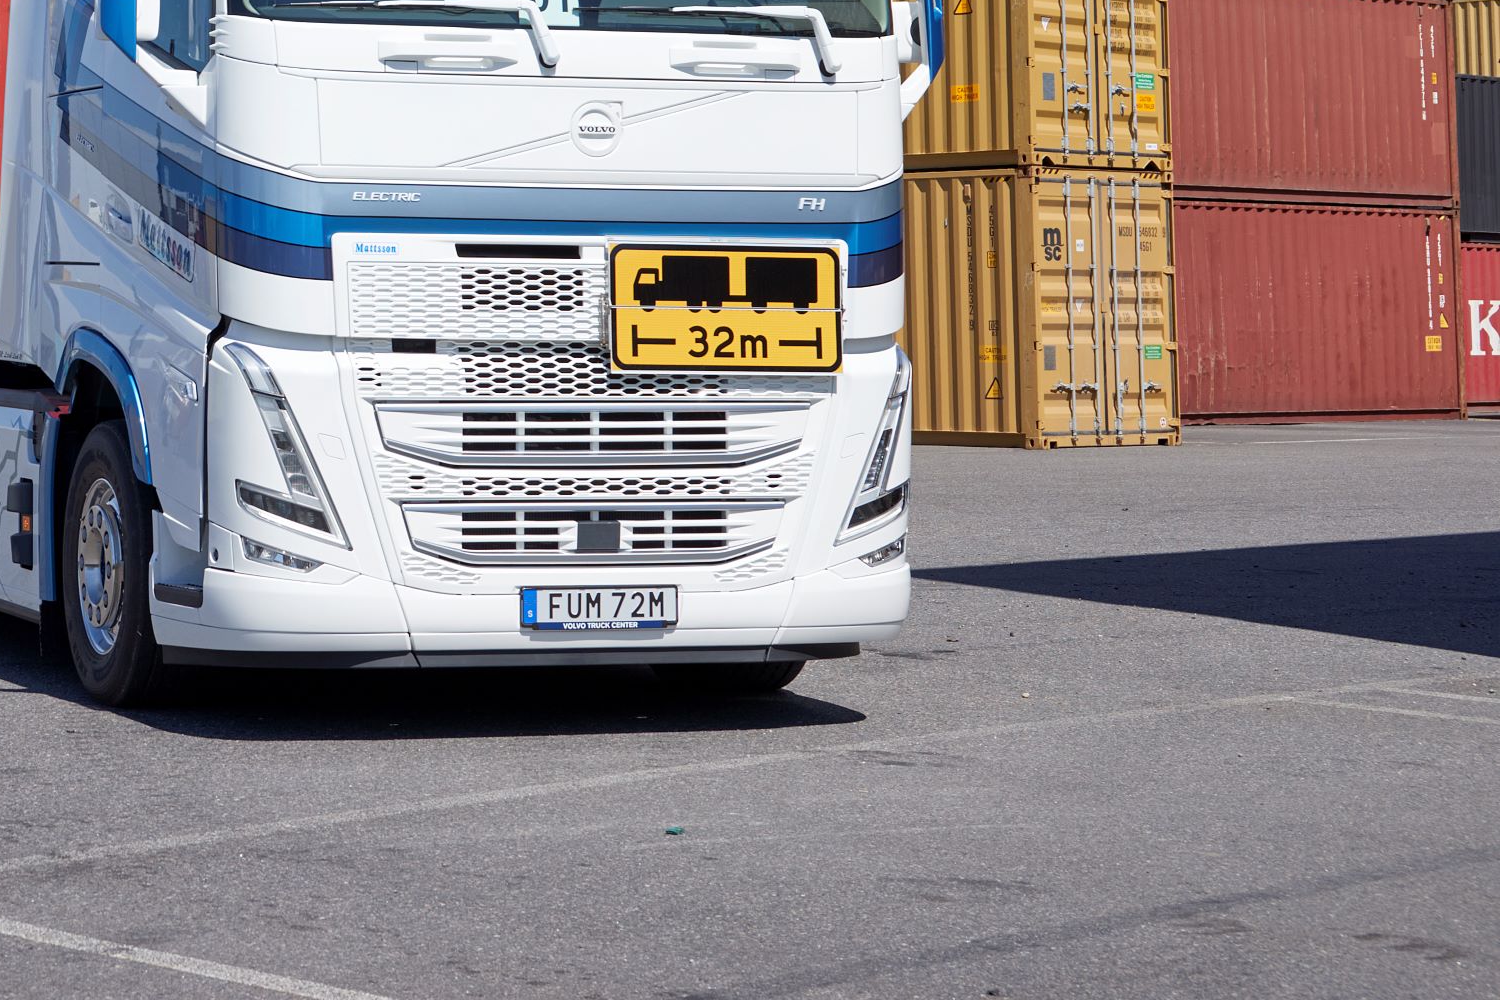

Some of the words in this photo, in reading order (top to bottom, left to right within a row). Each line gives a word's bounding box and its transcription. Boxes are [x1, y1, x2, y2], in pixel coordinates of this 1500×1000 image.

[578, 125, 616, 134] VOLVO
[352, 190, 421, 202] ELECTRIC
[798, 198, 826, 212] FH
[1118, 226, 1132, 237] MSDU
[354, 242, 398, 254] Mattsson
[689, 326, 769, 358] 32m
[549, 592, 601, 619] FUM
[612, 591, 664, 618] 72M
[528, 610, 533, 618] S
[563, 622, 587, 630] VOLVO
[611, 621, 638, 629] CENTER
